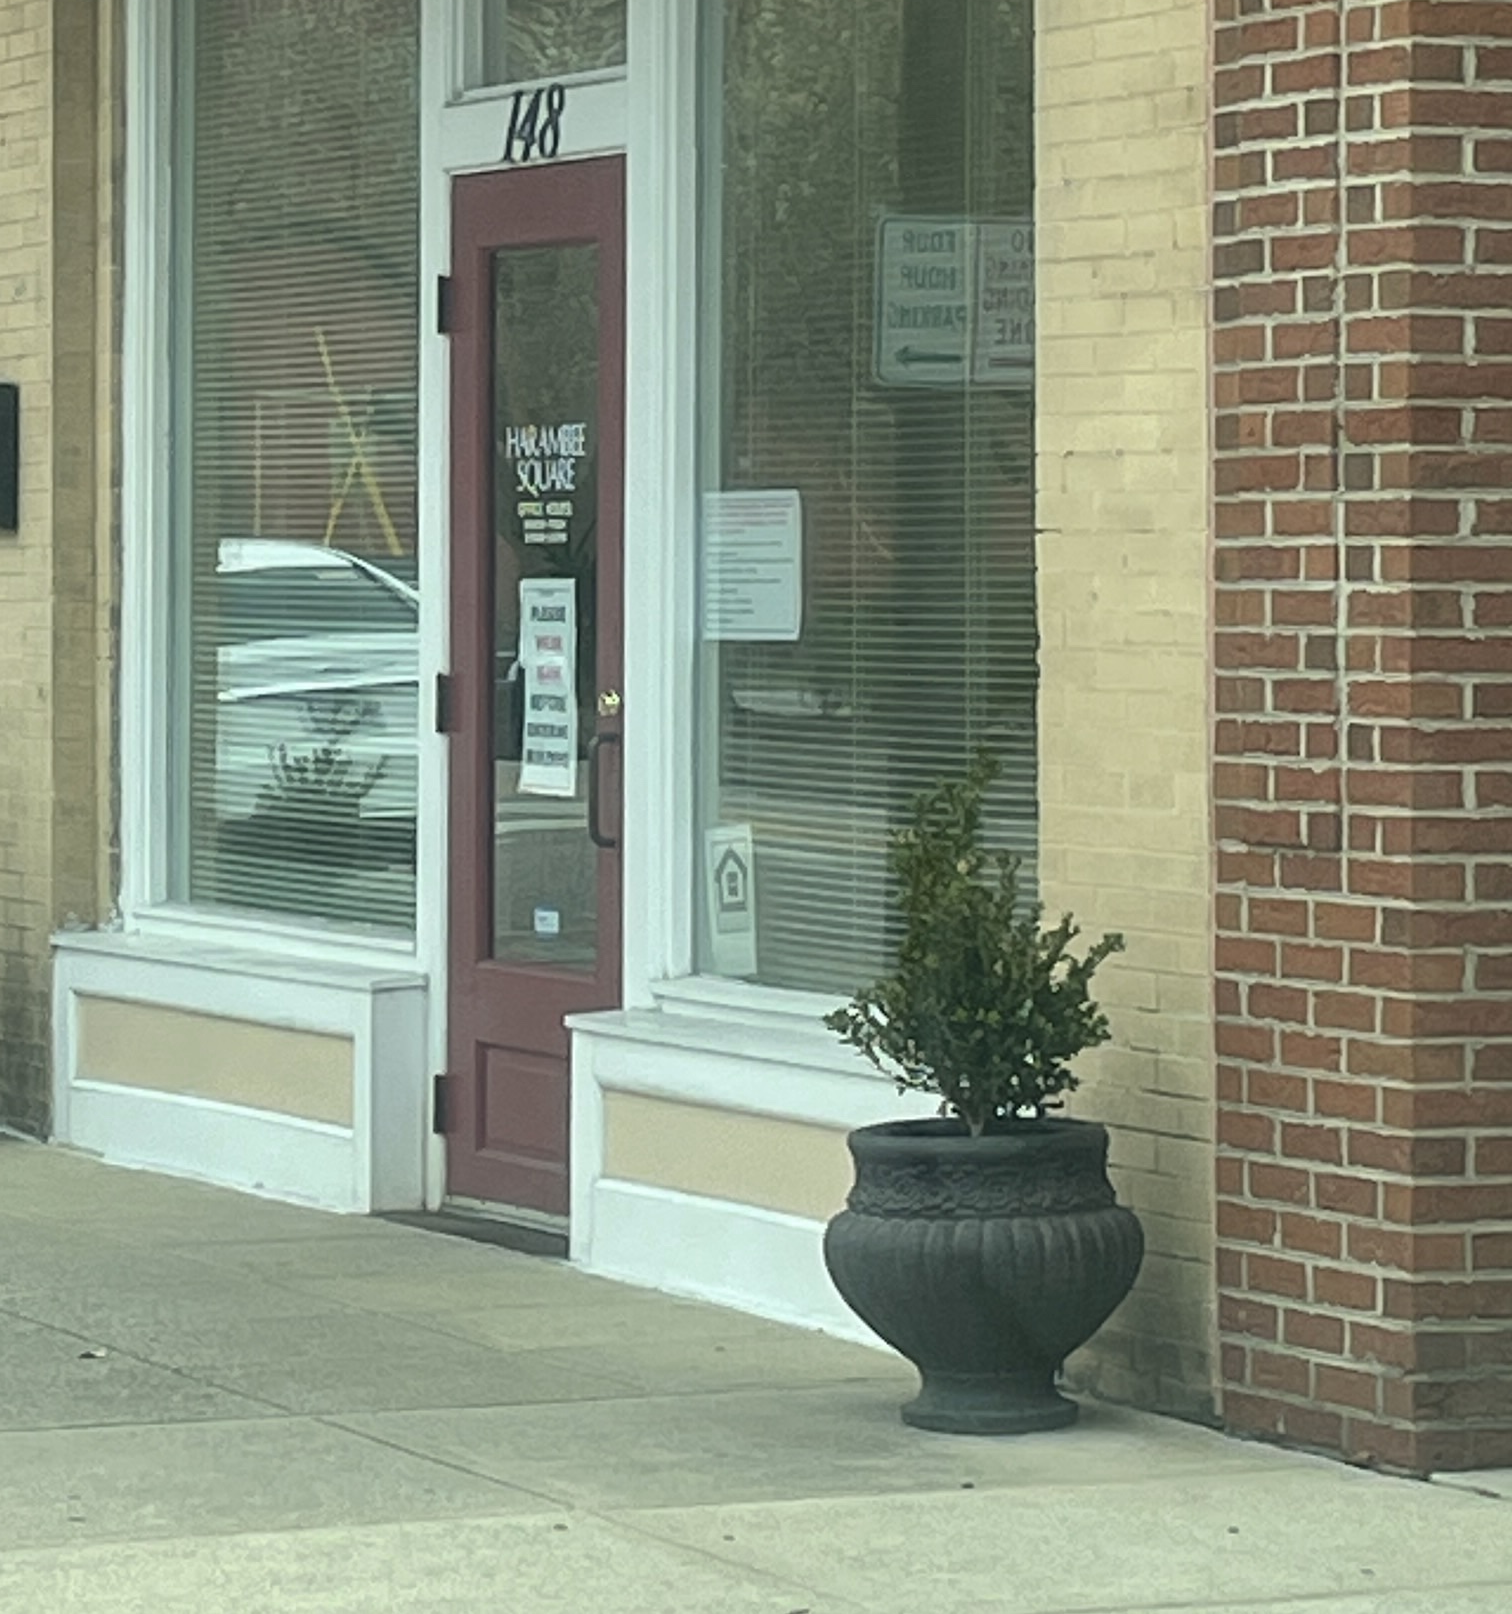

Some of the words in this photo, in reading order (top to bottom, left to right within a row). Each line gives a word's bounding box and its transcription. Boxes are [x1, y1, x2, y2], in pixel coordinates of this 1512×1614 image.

[500, 83, 565, 163] 148
[505, 422, 587, 458] HARAMBEE
[516, 458, 576, 498] SQUARE
